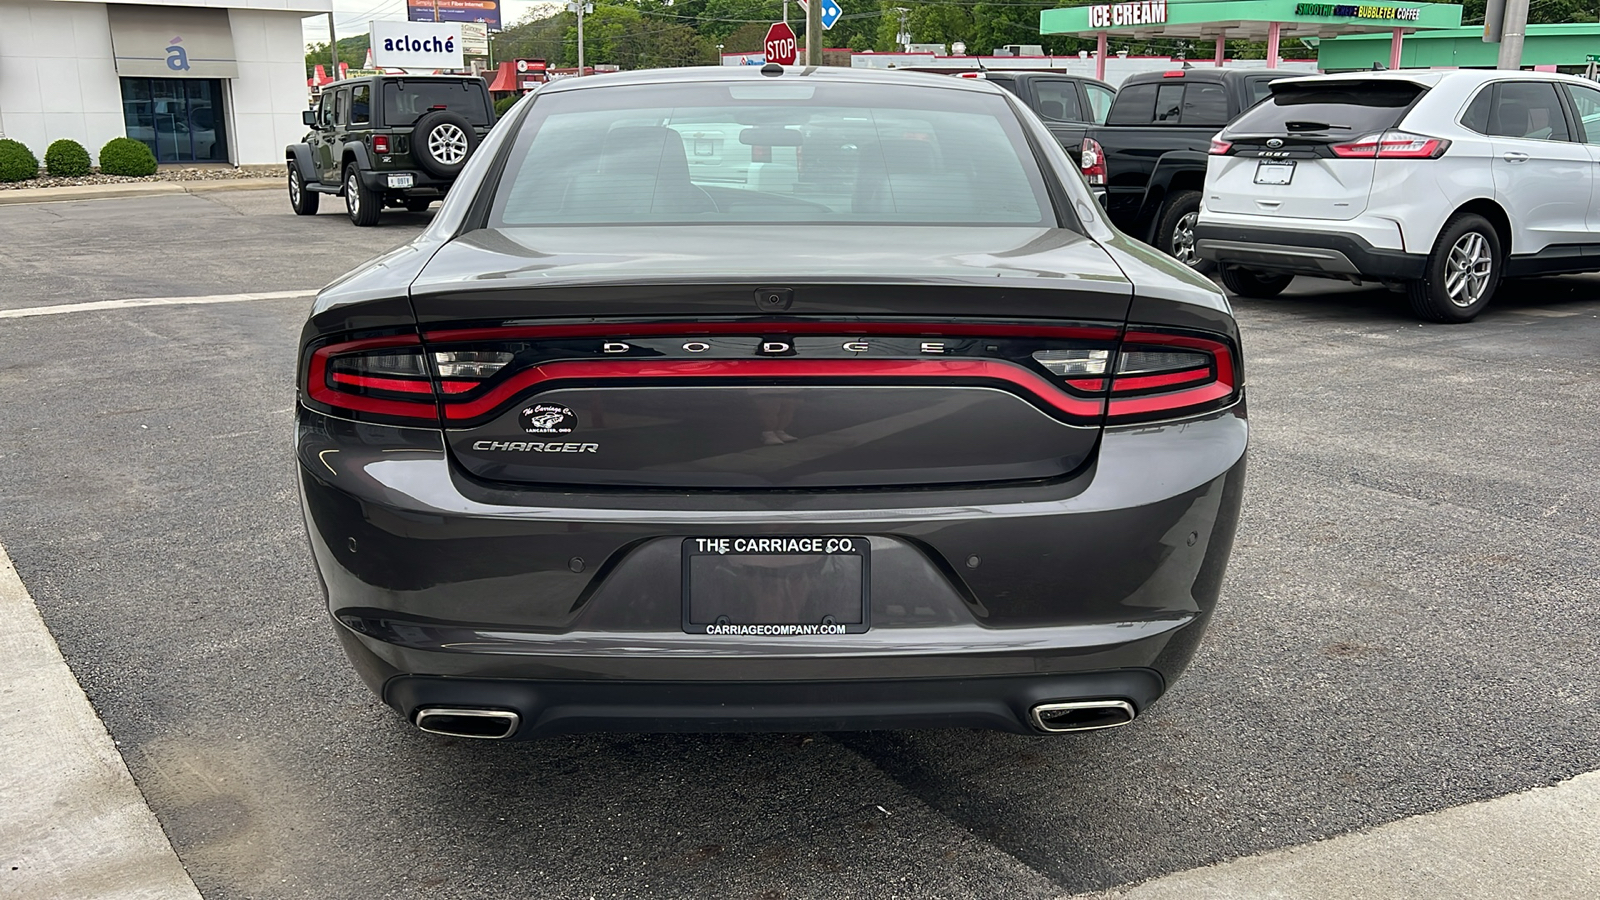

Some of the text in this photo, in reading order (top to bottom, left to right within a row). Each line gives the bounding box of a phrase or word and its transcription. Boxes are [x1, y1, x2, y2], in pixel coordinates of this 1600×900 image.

[1088, 1, 1167, 28] ICE CREAM
[1396, 7, 1420, 20] COFFEE
[384, 35, 454, 53] acloché
[767, 38, 794, 60] STOP
[165, 36, 190, 71] á
[604, 342, 945, 353] DODGE
[523, 408, 533, 416] The
[535, 405, 561, 413] Carriage
[472, 440, 599, 453] CHARGER
[696, 538, 856, 552] THE CARRIAGE CO.
[706, 624, 846, 635] CARRIAGECOMPANY.COM
